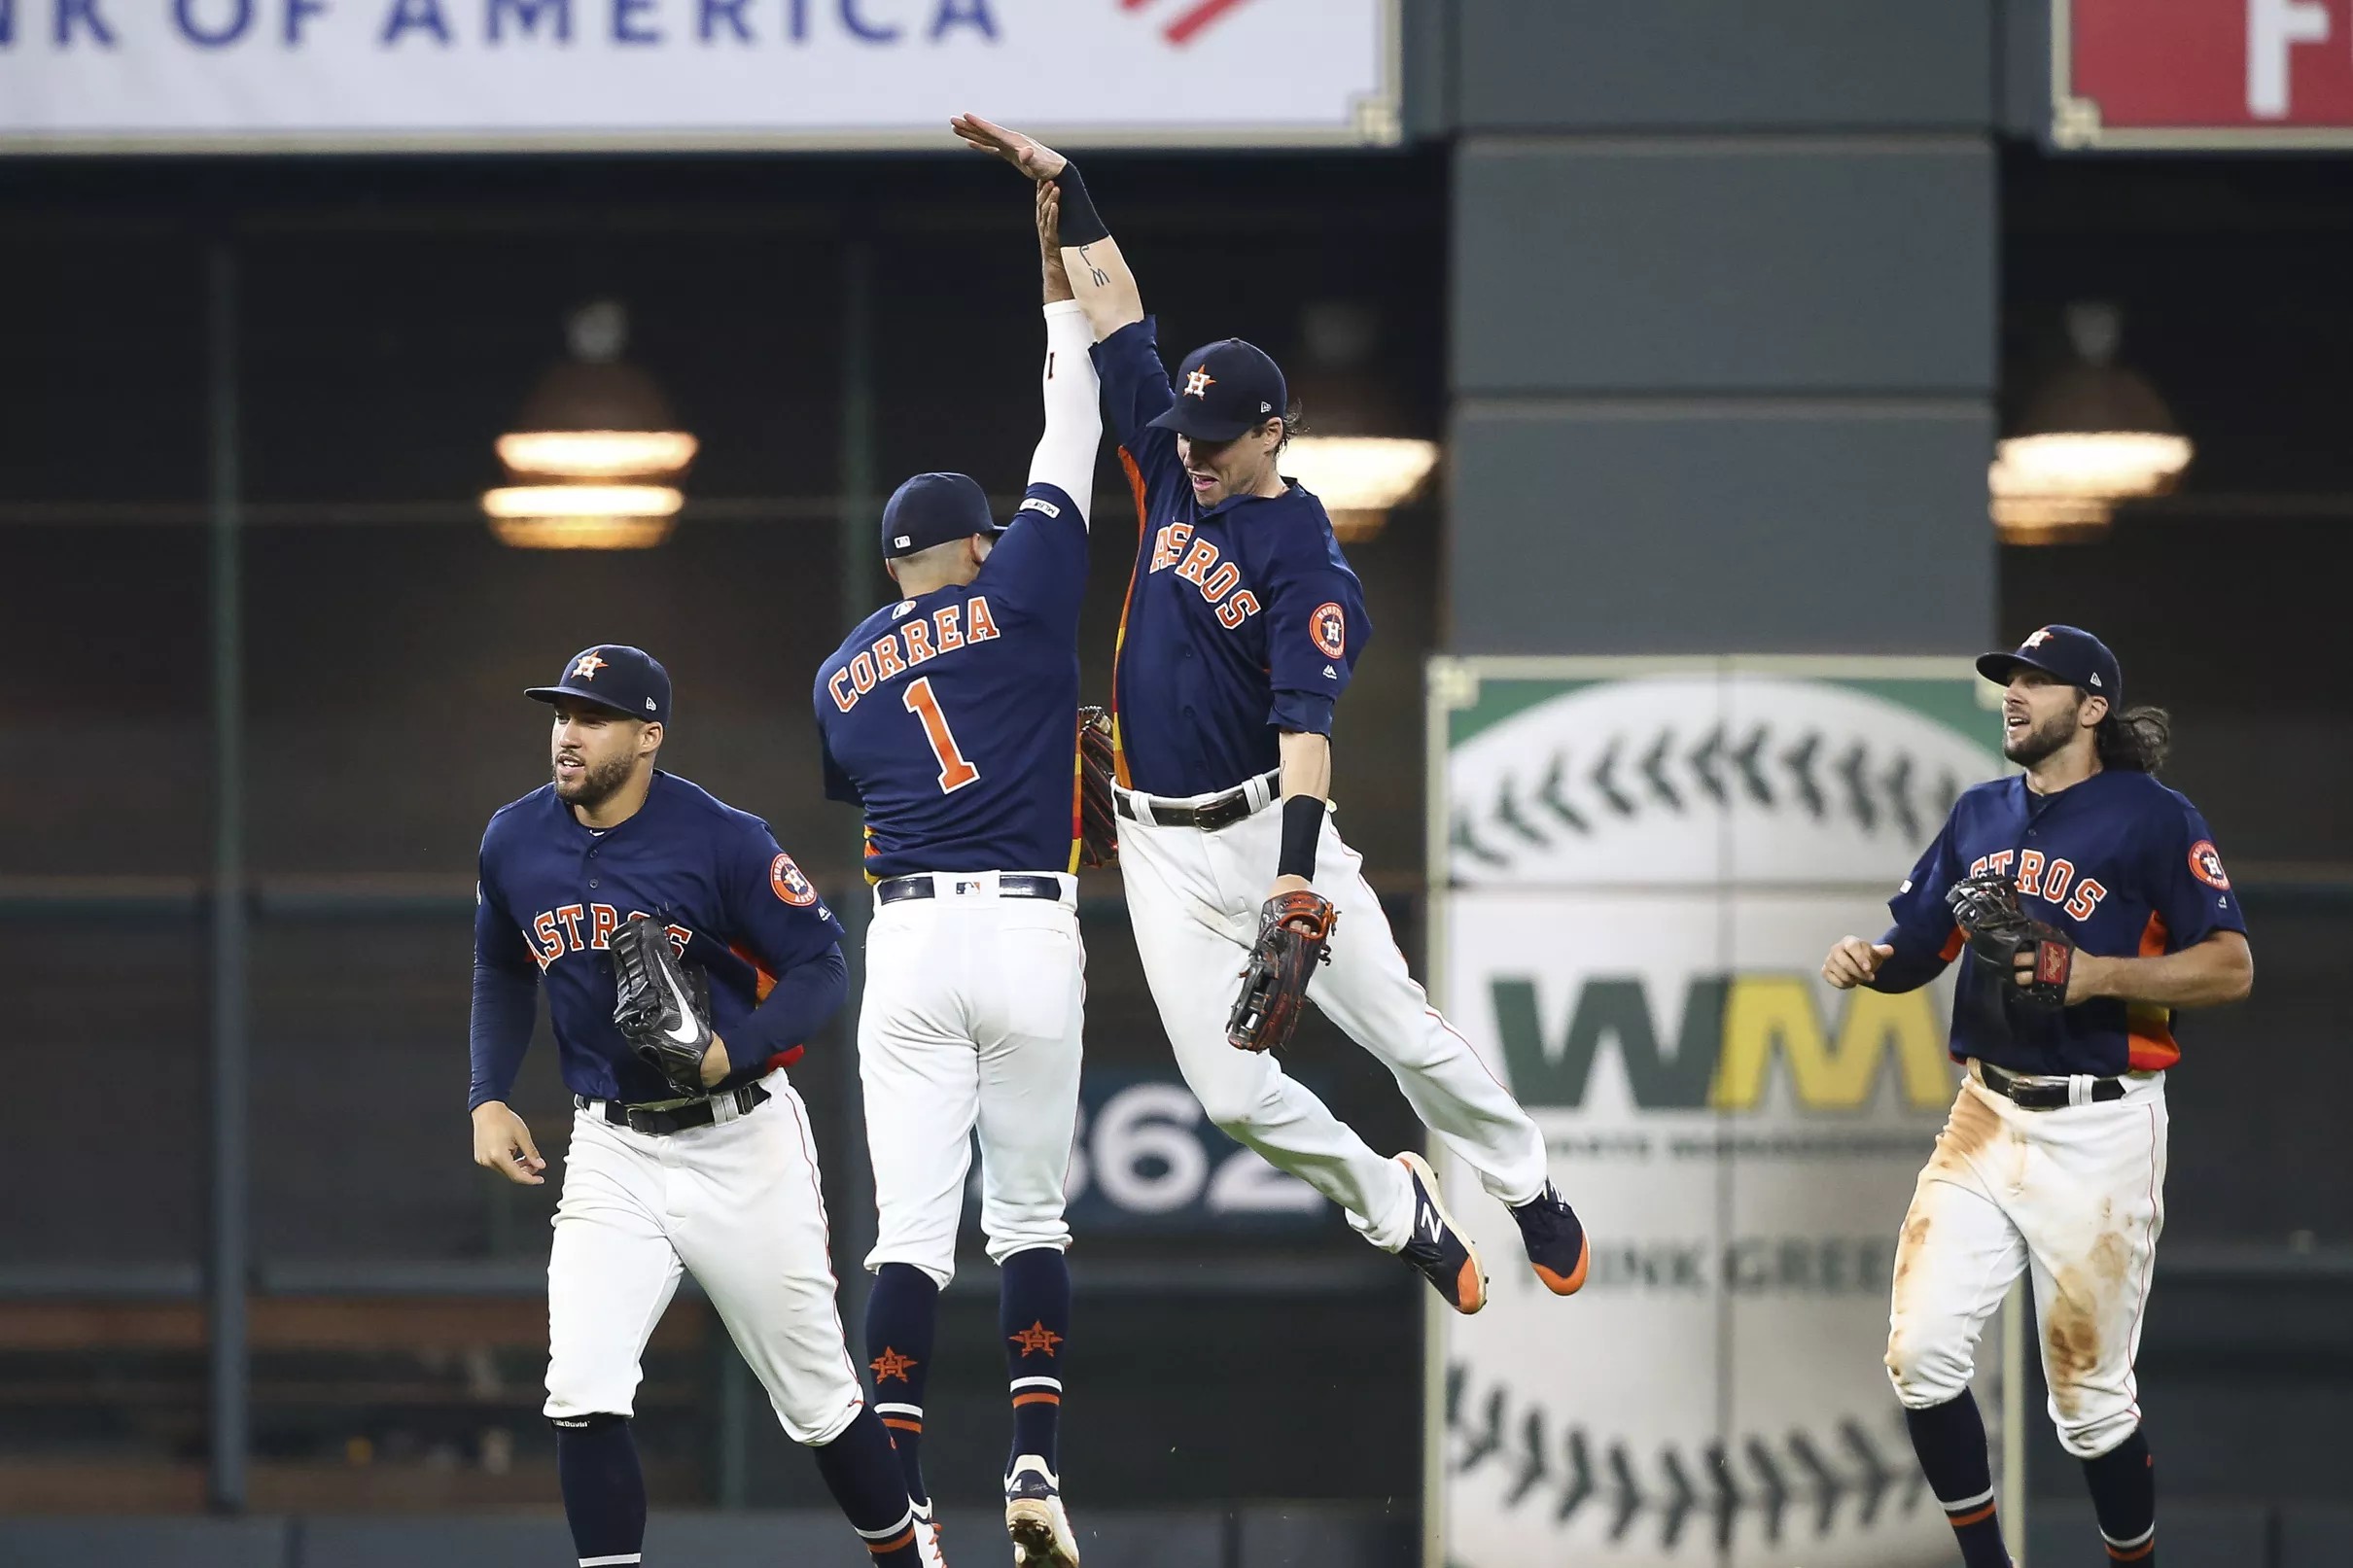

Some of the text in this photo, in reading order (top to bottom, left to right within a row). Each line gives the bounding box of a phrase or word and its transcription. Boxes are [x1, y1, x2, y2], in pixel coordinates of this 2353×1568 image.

[172, 0, 333, 49] OF
[378, 0, 1000, 47] AMERICA
[1184, 369, 1212, 398] H
[828, 596, 1001, 713] CORREA
[902, 676, 980, 794] 1
[1970, 848, 2108, 923] TROS
[522, 903, 692, 975] STRS
[973, 1081, 1324, 1214] 62
[1725, 1237, 1893, 1296] GREE
